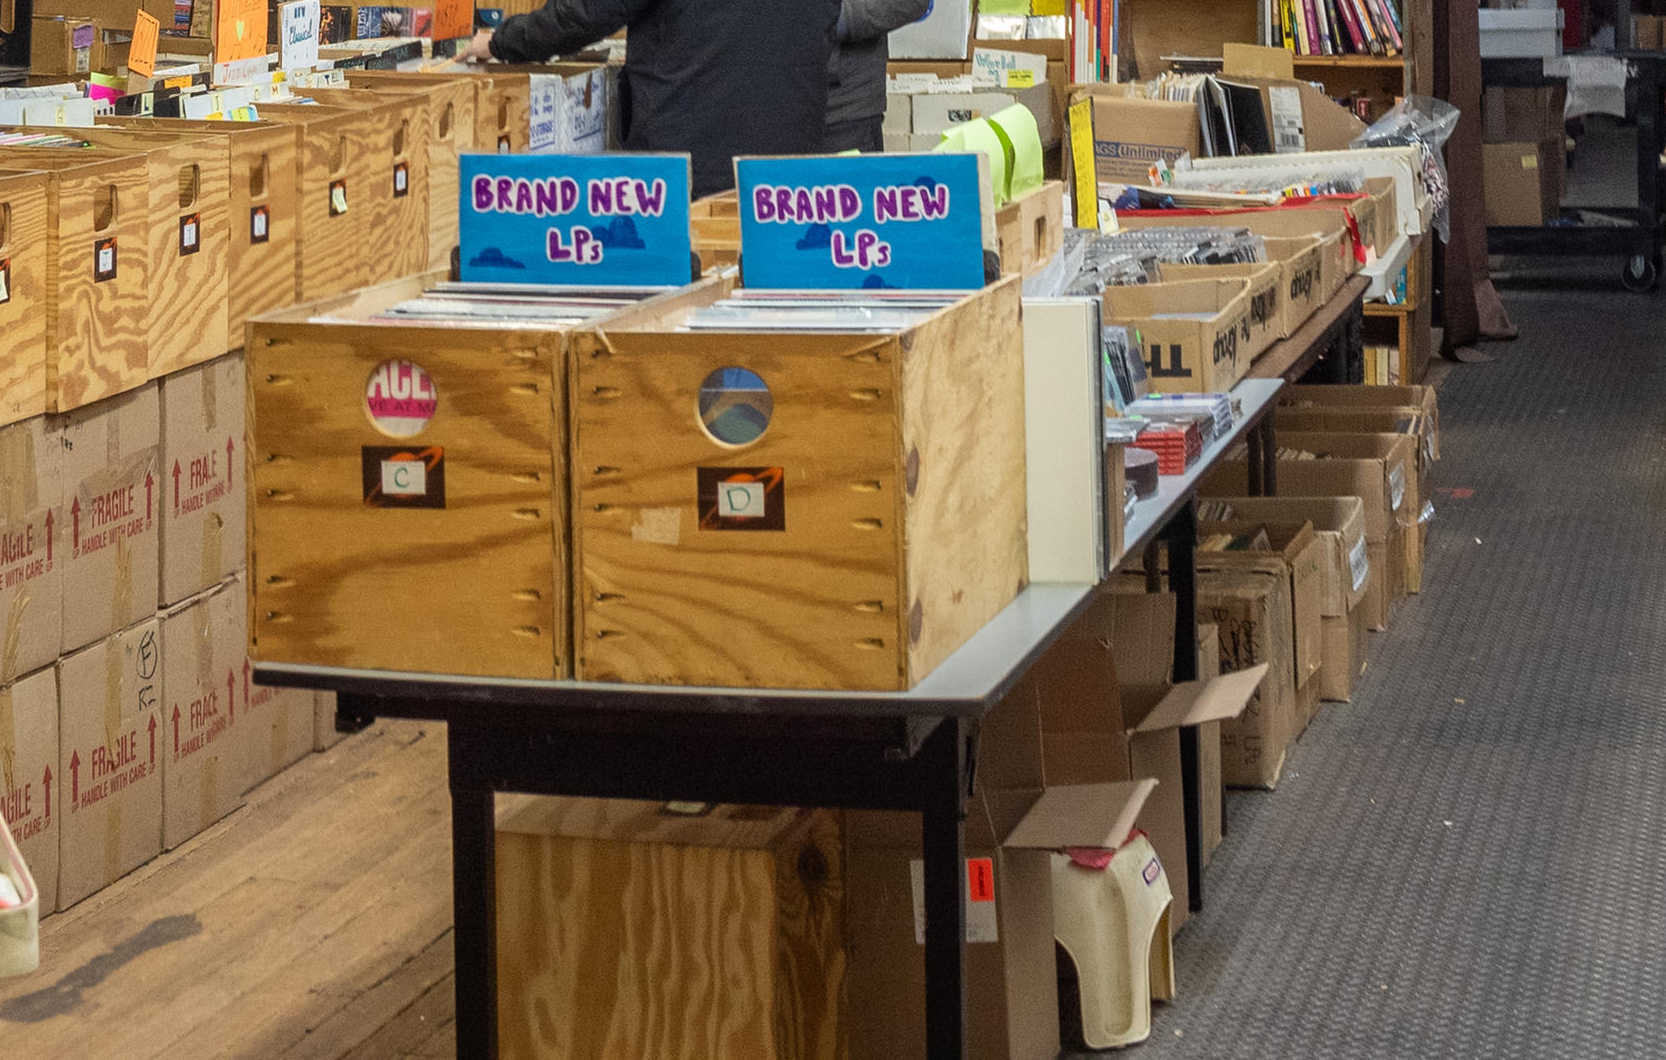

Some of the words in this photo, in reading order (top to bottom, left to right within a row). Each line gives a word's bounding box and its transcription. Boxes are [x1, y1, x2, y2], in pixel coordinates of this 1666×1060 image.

[976, 53, 1016, 70] World
[472, 174, 580, 217] BRAND
[587, 177, 666, 217] NEW
[753, 184, 862, 223] BRAND
[873, 182, 950, 221] NEW
[546, 226, 603, 265] LPs
[831, 229, 891, 269] LPs
[394, 467, 410, 489] C
[91, 484, 134, 528] FRAGILE
[181, 492, 204, 514] HANDLE
[726, 486, 751, 511] D
[81, 532, 106, 556] HANDLE
[108, 528, 125, 545] WITH
[126, 519, 143, 537] CARE
[5, 569, 24, 586] WITH
[26, 562, 44, 581] CARE
[91, 731, 137, 780] FRAGILE
[181, 732, 205, 758] HANDLE
[81, 782, 109, 808] HANDLE
[110, 774, 128, 796] WITH
[130, 765, 147, 788] CARE
[24, 816, 41, 838] CARE
